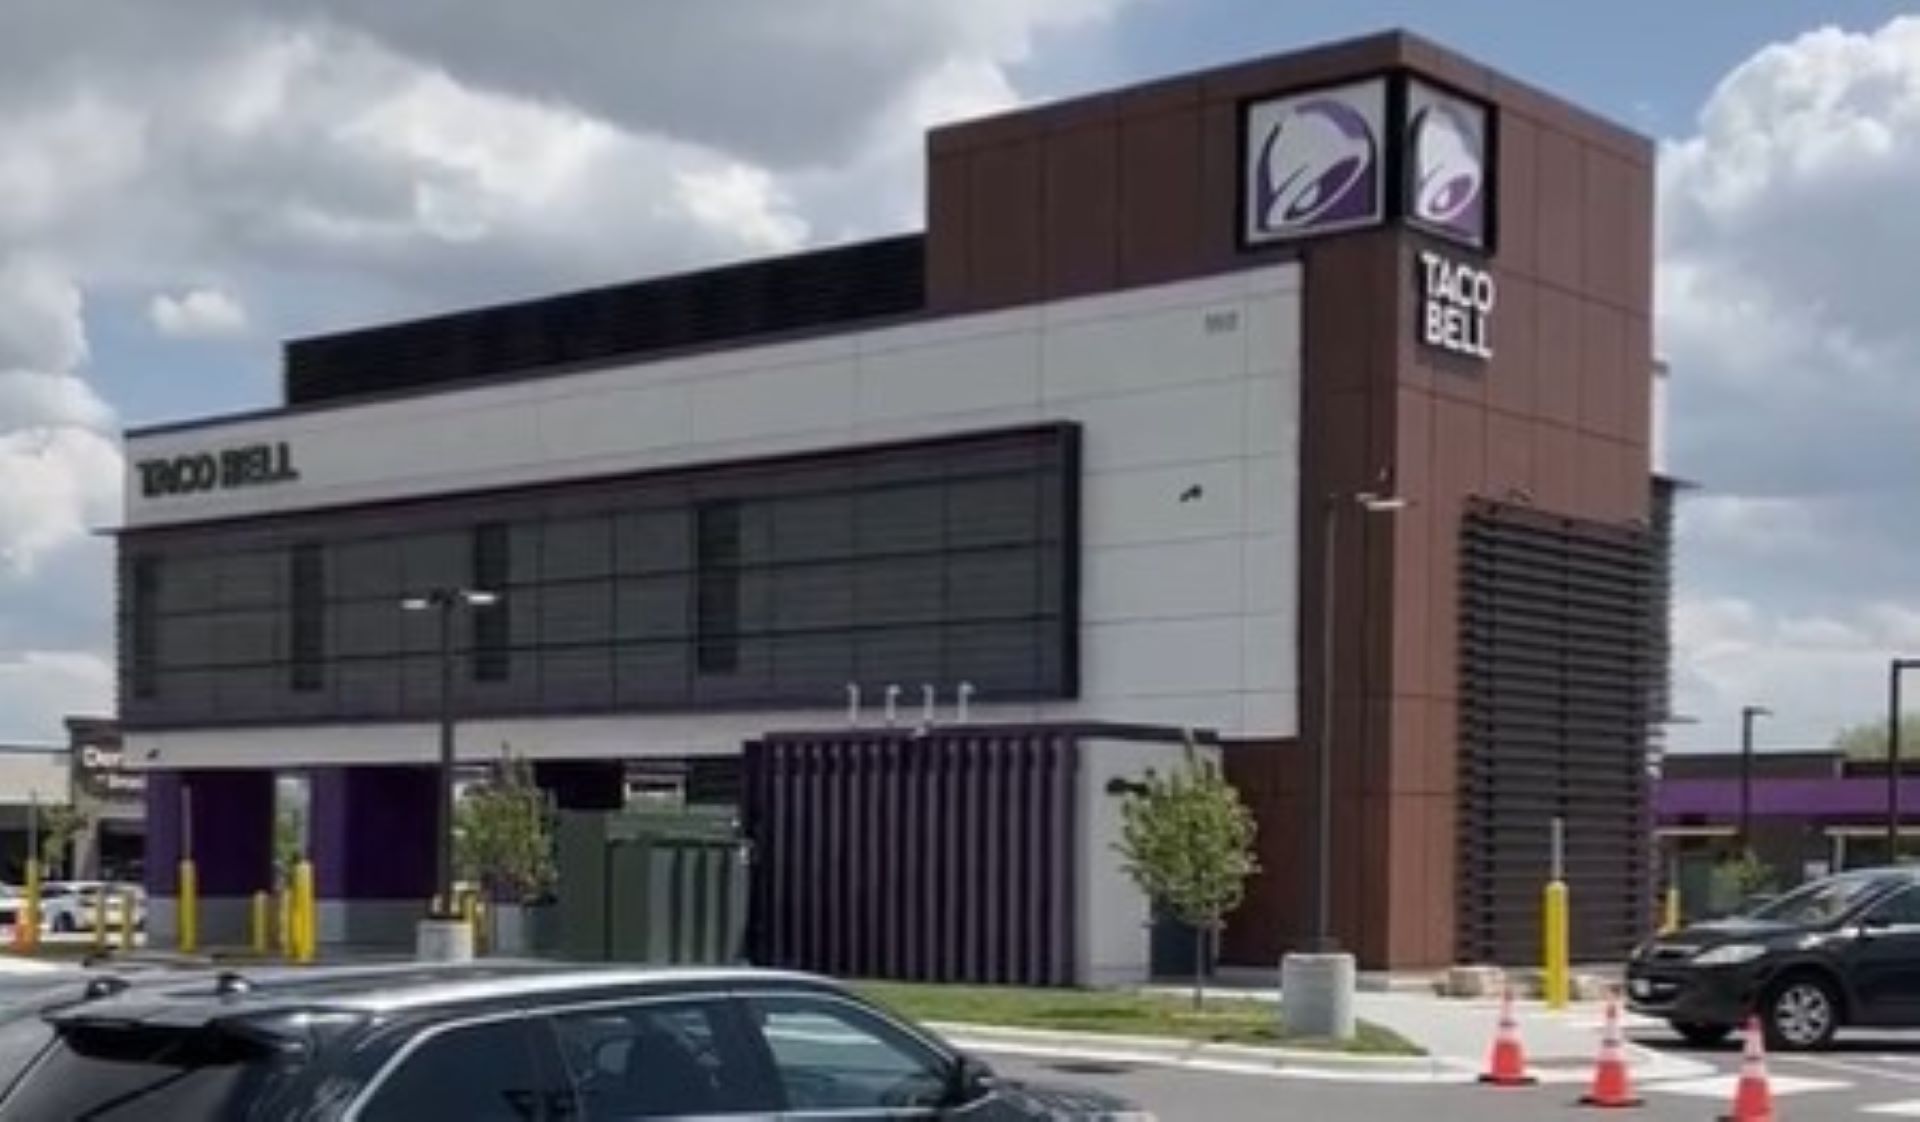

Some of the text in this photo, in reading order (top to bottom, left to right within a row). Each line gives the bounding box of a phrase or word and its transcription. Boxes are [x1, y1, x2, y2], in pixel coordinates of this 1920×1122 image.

[1421, 250, 1494, 313] TACO
[1426, 300, 1493, 359] BELL
[136, 441, 300, 498] TACO BELL
